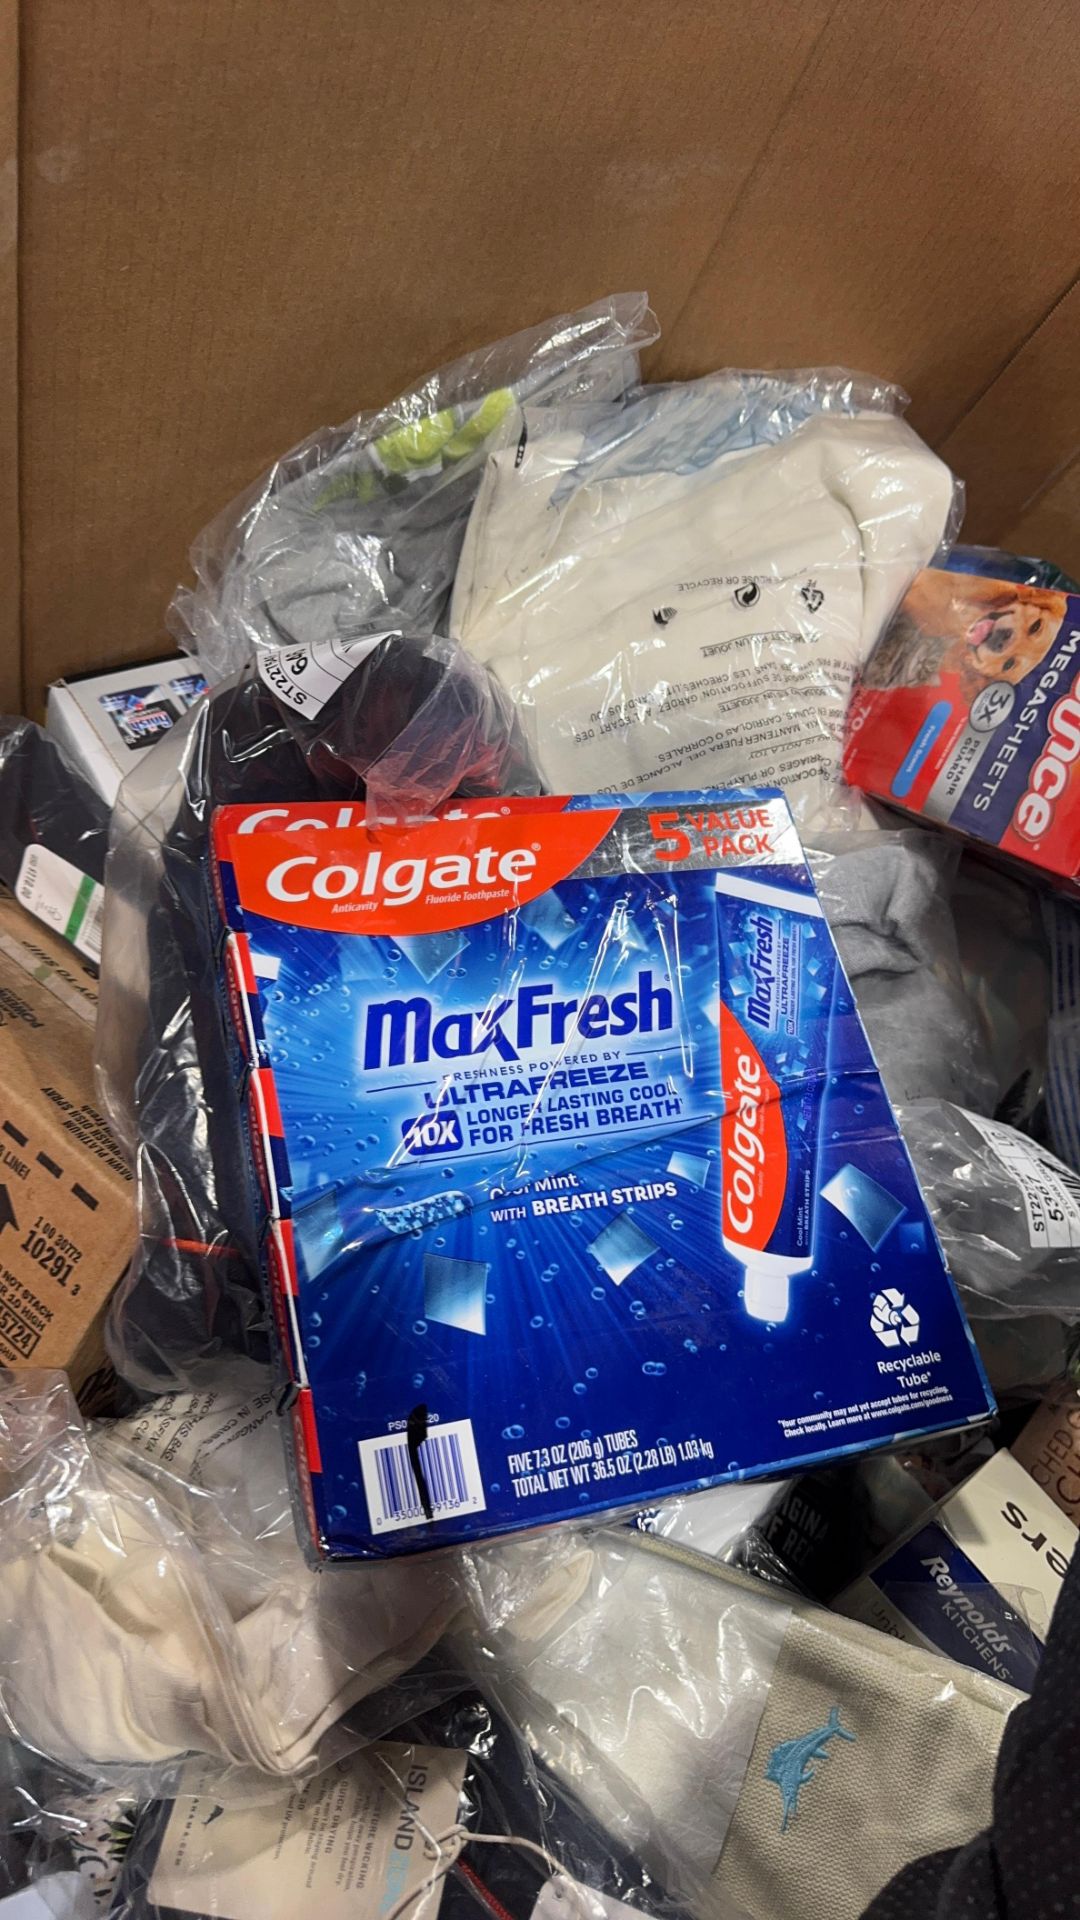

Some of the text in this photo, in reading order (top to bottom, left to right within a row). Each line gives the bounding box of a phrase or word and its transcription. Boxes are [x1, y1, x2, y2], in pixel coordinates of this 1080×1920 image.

[677, 577, 723, 592] RECYCLE
[702, 641, 734, 657] JOUET
[719, 696, 760, 713] JUGUETE
[575, 728, 595, 743] DES
[745, 724, 801, 745] MANTENER
[973, 630, 1080, 812] MEGASHEETS
[709, 739, 744, 752] FUERA
[946, 737, 972, 780] GUARD
[968, 740, 980, 764] PET
[621, 778, 637, 790] DE
[636, 760, 682, 784] ALCANCE
[761, 766, 775, 778] OR
[946, 765, 968, 796] HAIR
[647, 811, 692, 862] 5
[684, 808, 773, 833] VALUE
[702, 833, 775, 858] PACK
[265, 847, 538, 907] Colgate
[331, 888, 510, 914] Anticavity Fluoride Toothpaste
[747, 915, 776, 1029] MaxFresh
[780, 937, 790, 1015] ULTRAFREEZE
[363, 970, 673, 1070] MaxFresh
[442, 1050, 621, 1081] FRESHNESS POWERED BY
[424, 1061, 649, 1109] ULTRAFREEZE
[40, 1087, 93, 1130] DISH SPRAY
[467, 1082, 678, 1125] LONGER LASTING COOL
[62, 1119, 109, 1158] PLATINUM
[404, 1115, 459, 1148] 10X
[469, 1112, 592, 1147] FOR FRESH
[727, 1053, 765, 1235] Colgate
[3, 1151, 31, 1180] LINE!
[105, 1157, 134, 1181] DAWN
[535, 1173, 580, 1193] Mint
[490, 1181, 678, 1223] WITH BREATH STRIPS
[34, 1216, 44, 1229] 1
[796, 1207, 804, 1247] Cool Mint
[21, 1229, 75, 1287] 10291
[2, 1270, 25, 1291] NOT
[21, 1288, 55, 1322] STACK
[21, 1305, 46, 1332] HIGH
[876, 1350, 942, 1374] Recyclable
[237, 1404, 251, 1418] IN
[797, 1410, 832, 1425] community
[833, 1408, 847, 1419] may
[848, 1404, 859, 1413] not
[859, 1402, 869, 1413] yet
[870, 1398, 892, 1410] accept
[892, 1394, 909, 1405] tubes
[910, 1390, 919, 1400] for
[920, 1385, 949, 1399] recycling.
[784, 1427, 804, 1438] Check
[805, 1422, 828, 1434] locally.
[828, 1418, 847, 1429] Learn
[847, 1415, 863, 1424] more
[161, 1437, 182, 1463] BAG
[507, 1429, 639, 1475] FIVE 7.3 OZ (206 g) TUBES
[511, 1438, 714, 1498] TOTAL NET WT 36.5 OZ (2.28 LB) 1.03 kg
[376, 1517, 383, 1526] 0
[472, 1496, 478, 1505] 2
[919, 1556, 1010, 1653] Reynolds
[941, 1601, 1009, 1680] KITCHENS
[335, 1780, 349, 1812] QUICK
[393, 1764, 429, 1851] ISLAND
[324, 1815, 340, 1854] DRYING
[356, 1841, 376, 1889] WICKING
